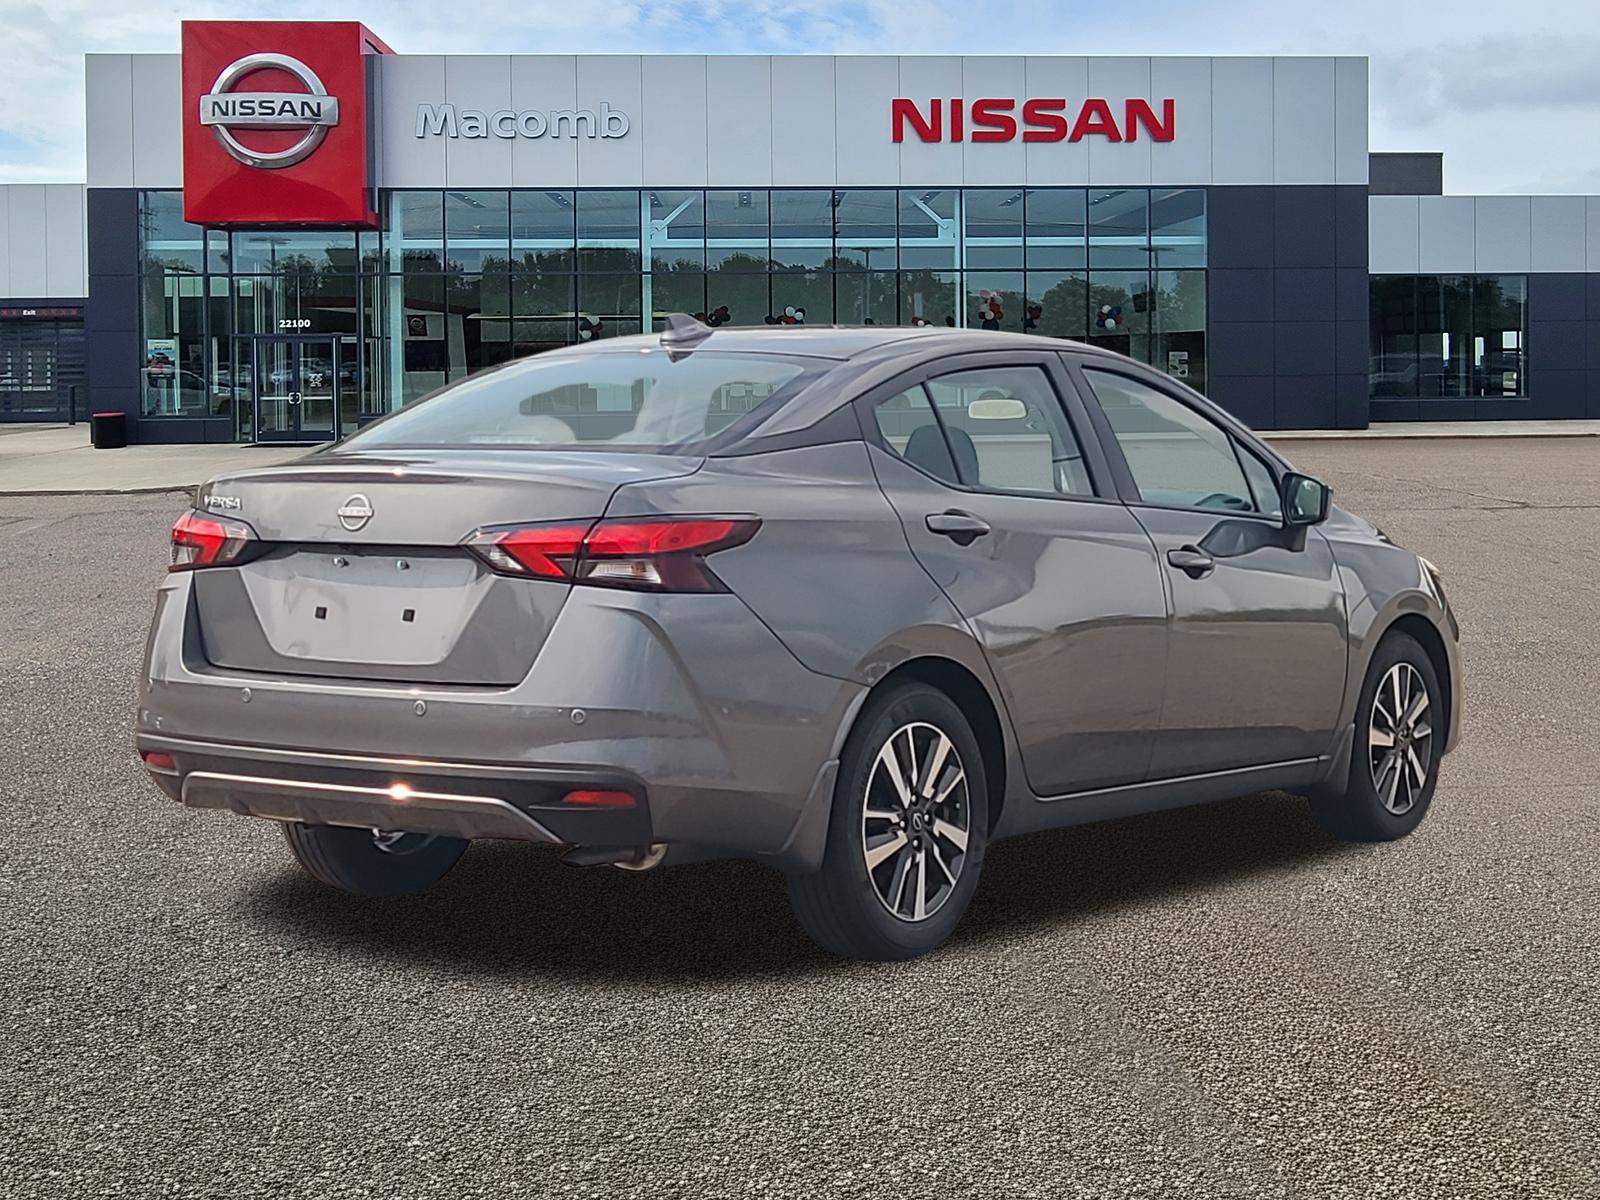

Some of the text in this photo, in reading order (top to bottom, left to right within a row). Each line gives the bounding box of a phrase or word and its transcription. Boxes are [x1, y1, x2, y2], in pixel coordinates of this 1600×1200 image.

[211, 99, 322, 119] NISSAN
[415, 102, 630, 139] Macomb
[892, 98, 1175, 143] NISSAN
[279, 319, 311, 328] 22100
[204, 495, 241, 509] VERSA
